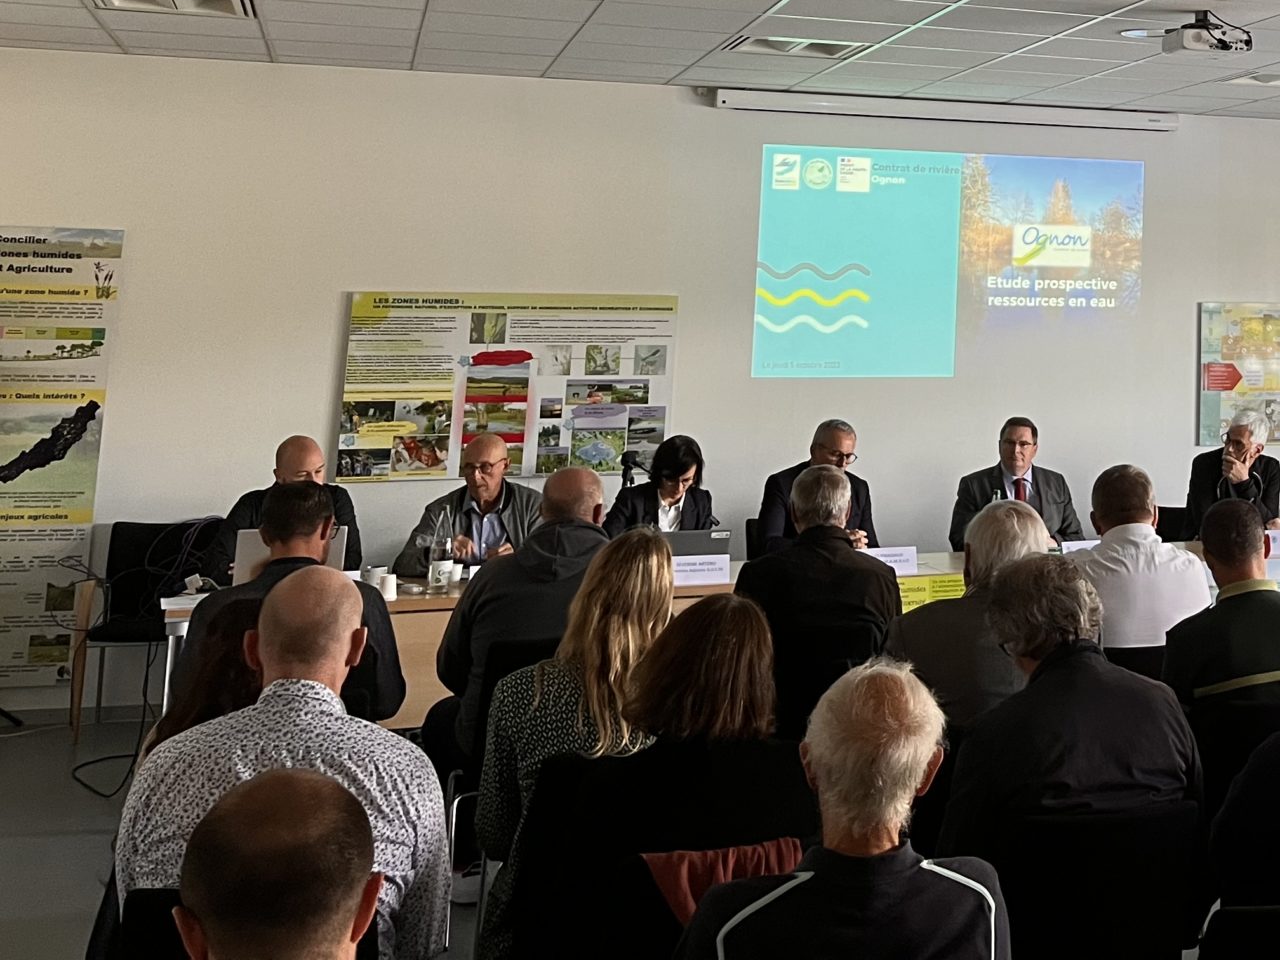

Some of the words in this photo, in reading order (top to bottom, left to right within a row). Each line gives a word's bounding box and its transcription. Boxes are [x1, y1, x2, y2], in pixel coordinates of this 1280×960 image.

[871, 163, 910, 173] Contrat
[913, 164, 926, 174] de
[928, 165, 960, 175] rivière
[871, 175, 906, 185] Ognon
[1022, 226, 1090, 249] Ognon
[0, 251, 29, 259] ones
[32, 250, 83, 260] humides
[6, 264, 73, 274] Agriculture
[987, 276, 1031, 289] Etude
[1034, 277, 1118, 292] prospective
[48, 288, 81, 296] humide
[987, 296, 1065, 307] ressources
[1068, 297, 1087, 308] en
[1089, 297, 1116, 308] eau
[43, 392, 77, 400] intérêts
[0, 514, 25, 522] njeux
[27, 513, 69, 522] agricoles
